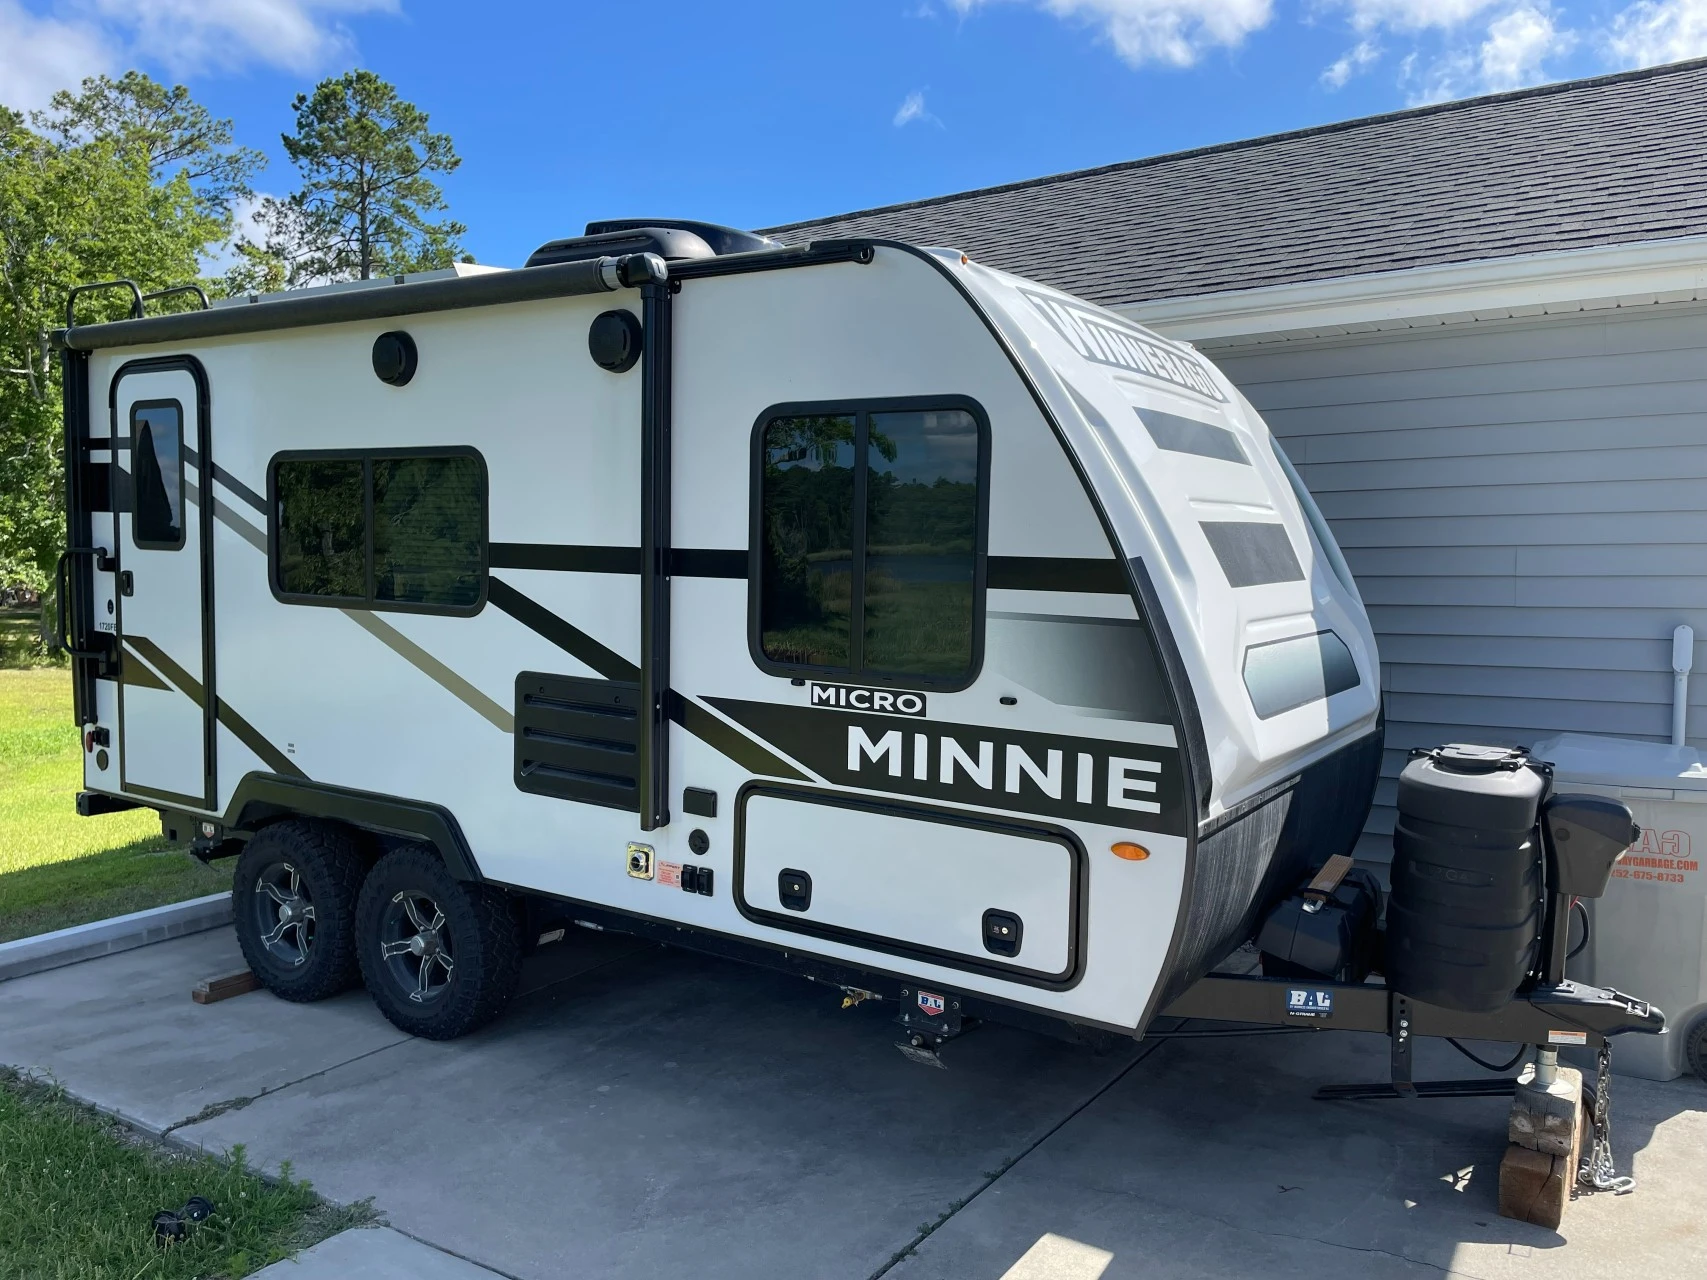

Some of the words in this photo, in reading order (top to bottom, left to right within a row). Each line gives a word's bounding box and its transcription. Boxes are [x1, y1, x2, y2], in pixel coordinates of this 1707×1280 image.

[1023, 292, 1225, 402] WINNEBAGO
[811, 685, 925, 715] MICRO
[847, 725, 1163, 815] MINNIE
